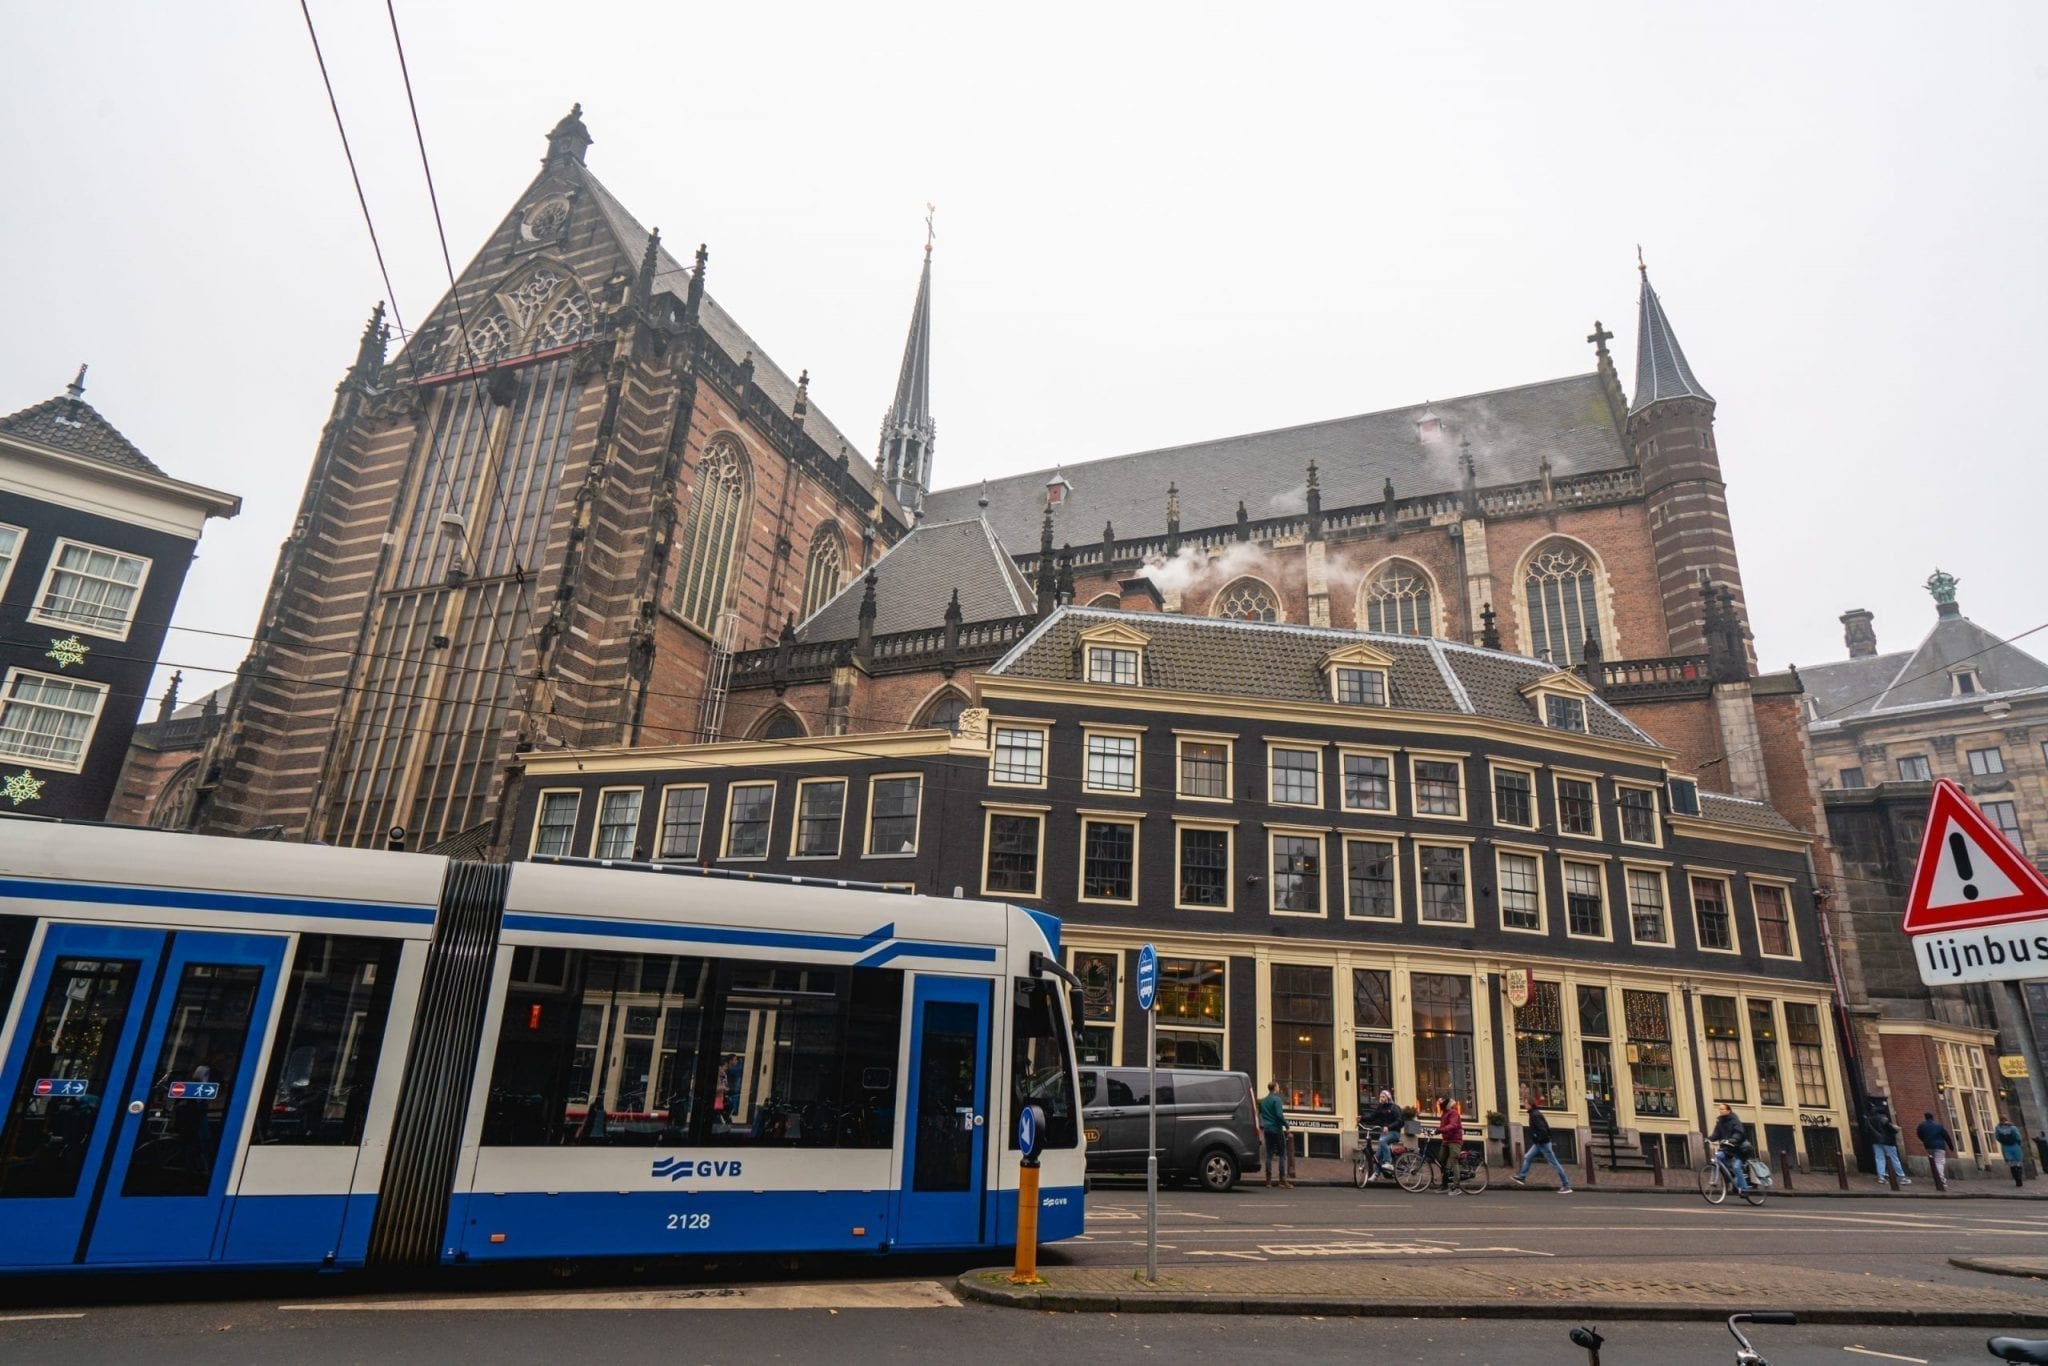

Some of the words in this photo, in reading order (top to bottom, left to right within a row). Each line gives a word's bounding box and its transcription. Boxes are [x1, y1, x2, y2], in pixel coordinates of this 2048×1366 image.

[1926, 935, 2048, 976] lijnbus
[697, 1161, 742, 1177] GVB
[667, 1213, 710, 1229] 2128
